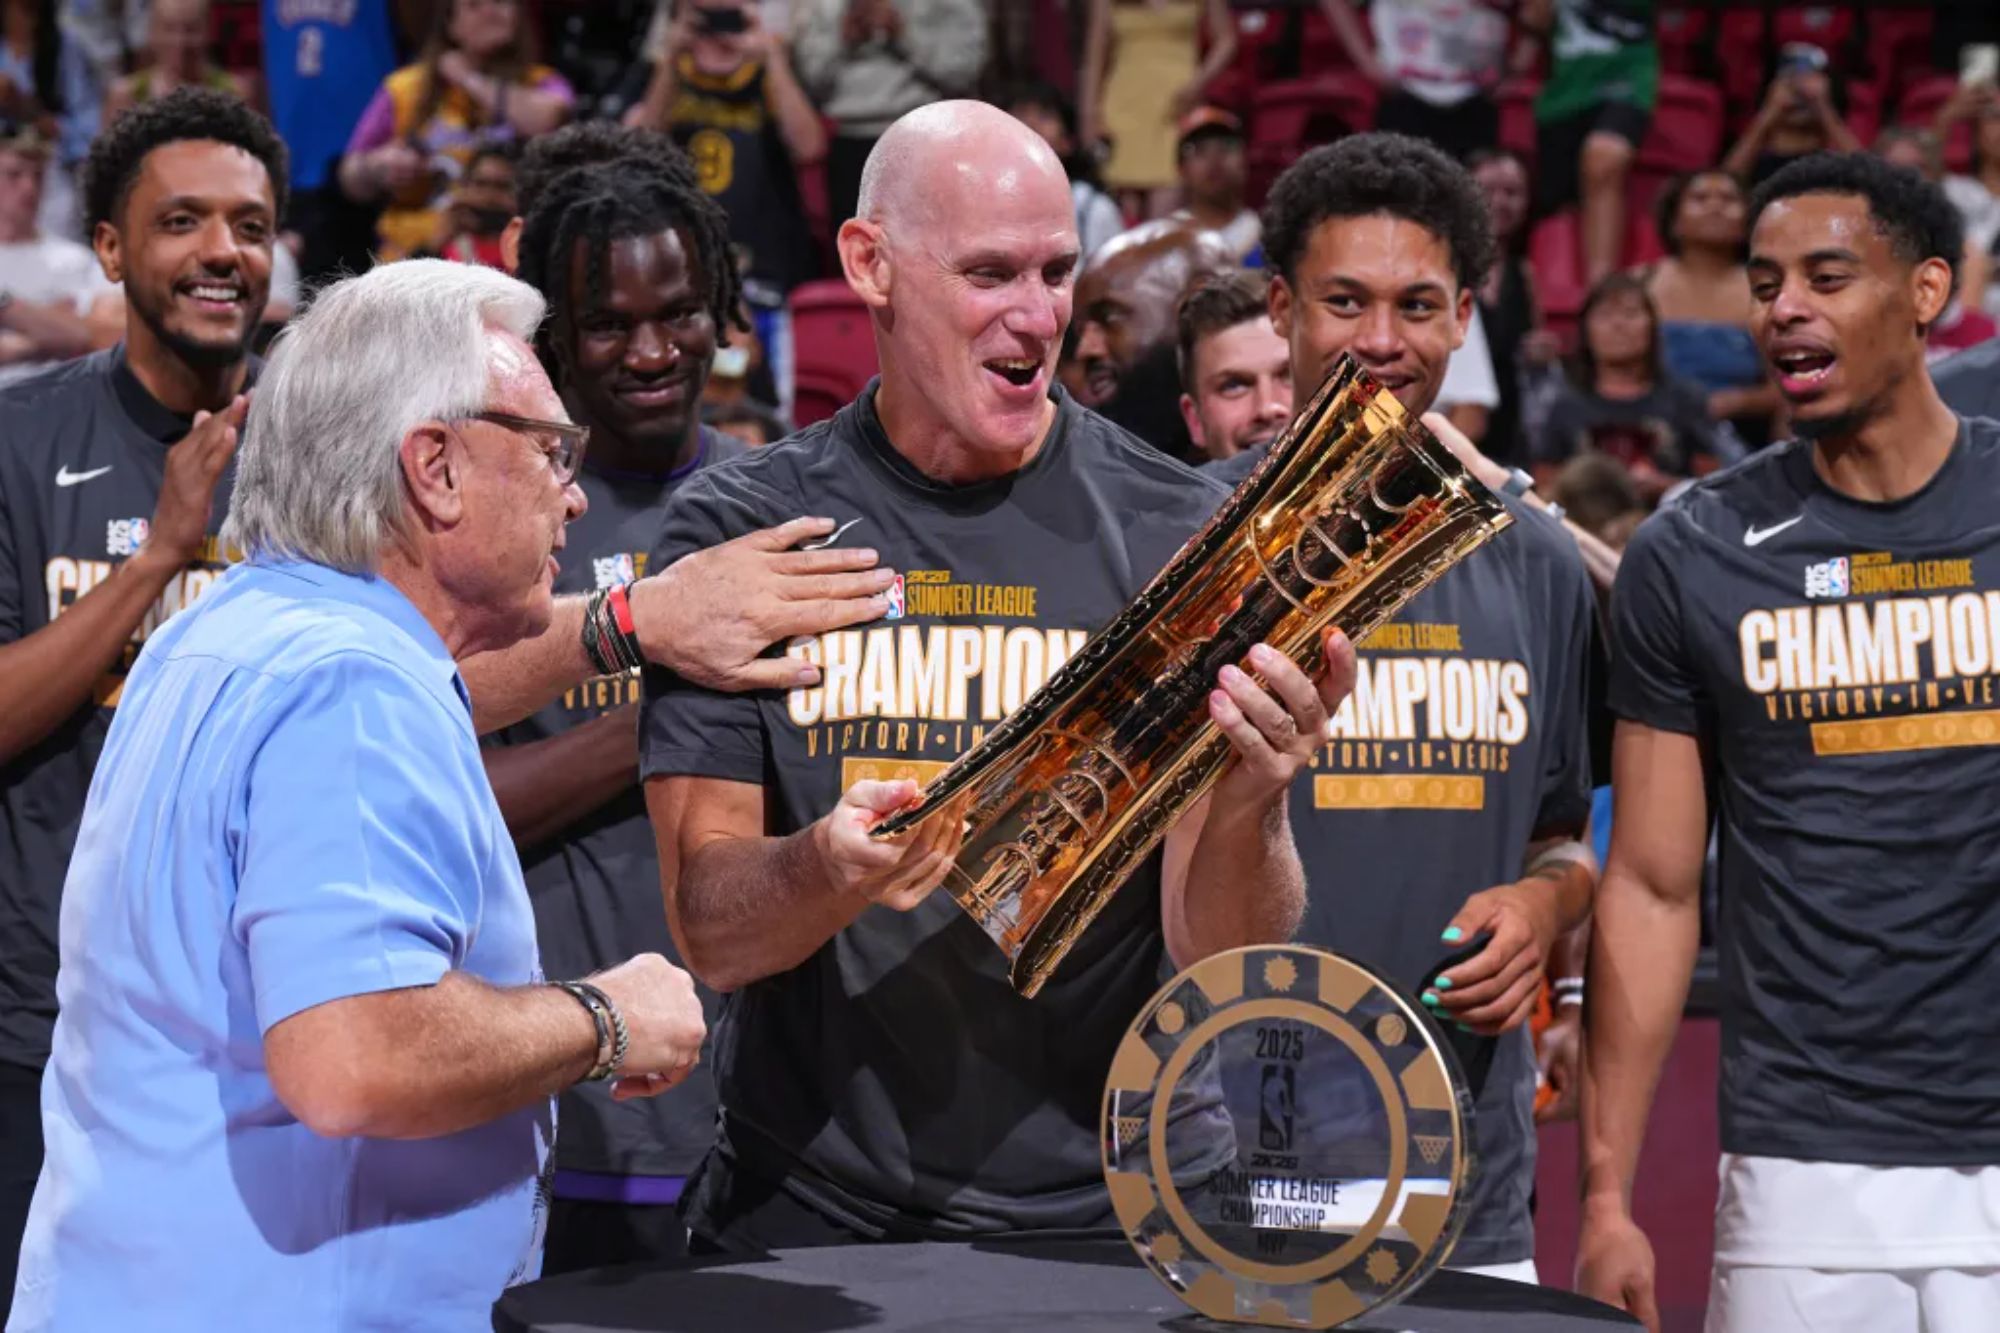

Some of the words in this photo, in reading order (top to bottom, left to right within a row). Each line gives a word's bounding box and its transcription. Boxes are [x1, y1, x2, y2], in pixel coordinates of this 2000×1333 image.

[1851, 562, 1916, 595] SUMMER
[1917, 558, 1975, 589] LEAGUE
[907, 584, 973, 616] SUMMER
[975, 583, 1038, 618] LEAGUE
[1765, 686, 1884, 721] VICTORY
[1910, 681, 1939, 709] IN
[807, 720, 929, 757] VICTORY
[1255, 1027, 1304, 1061] 2025
[1208, 1169, 1276, 1199] SUMMER
[1280, 1176, 1341, 1205] LEAGUE
[1220, 1198, 1326, 1231] CHAMPIONSHIP
[1257, 1231, 1289, 1255] MVP
